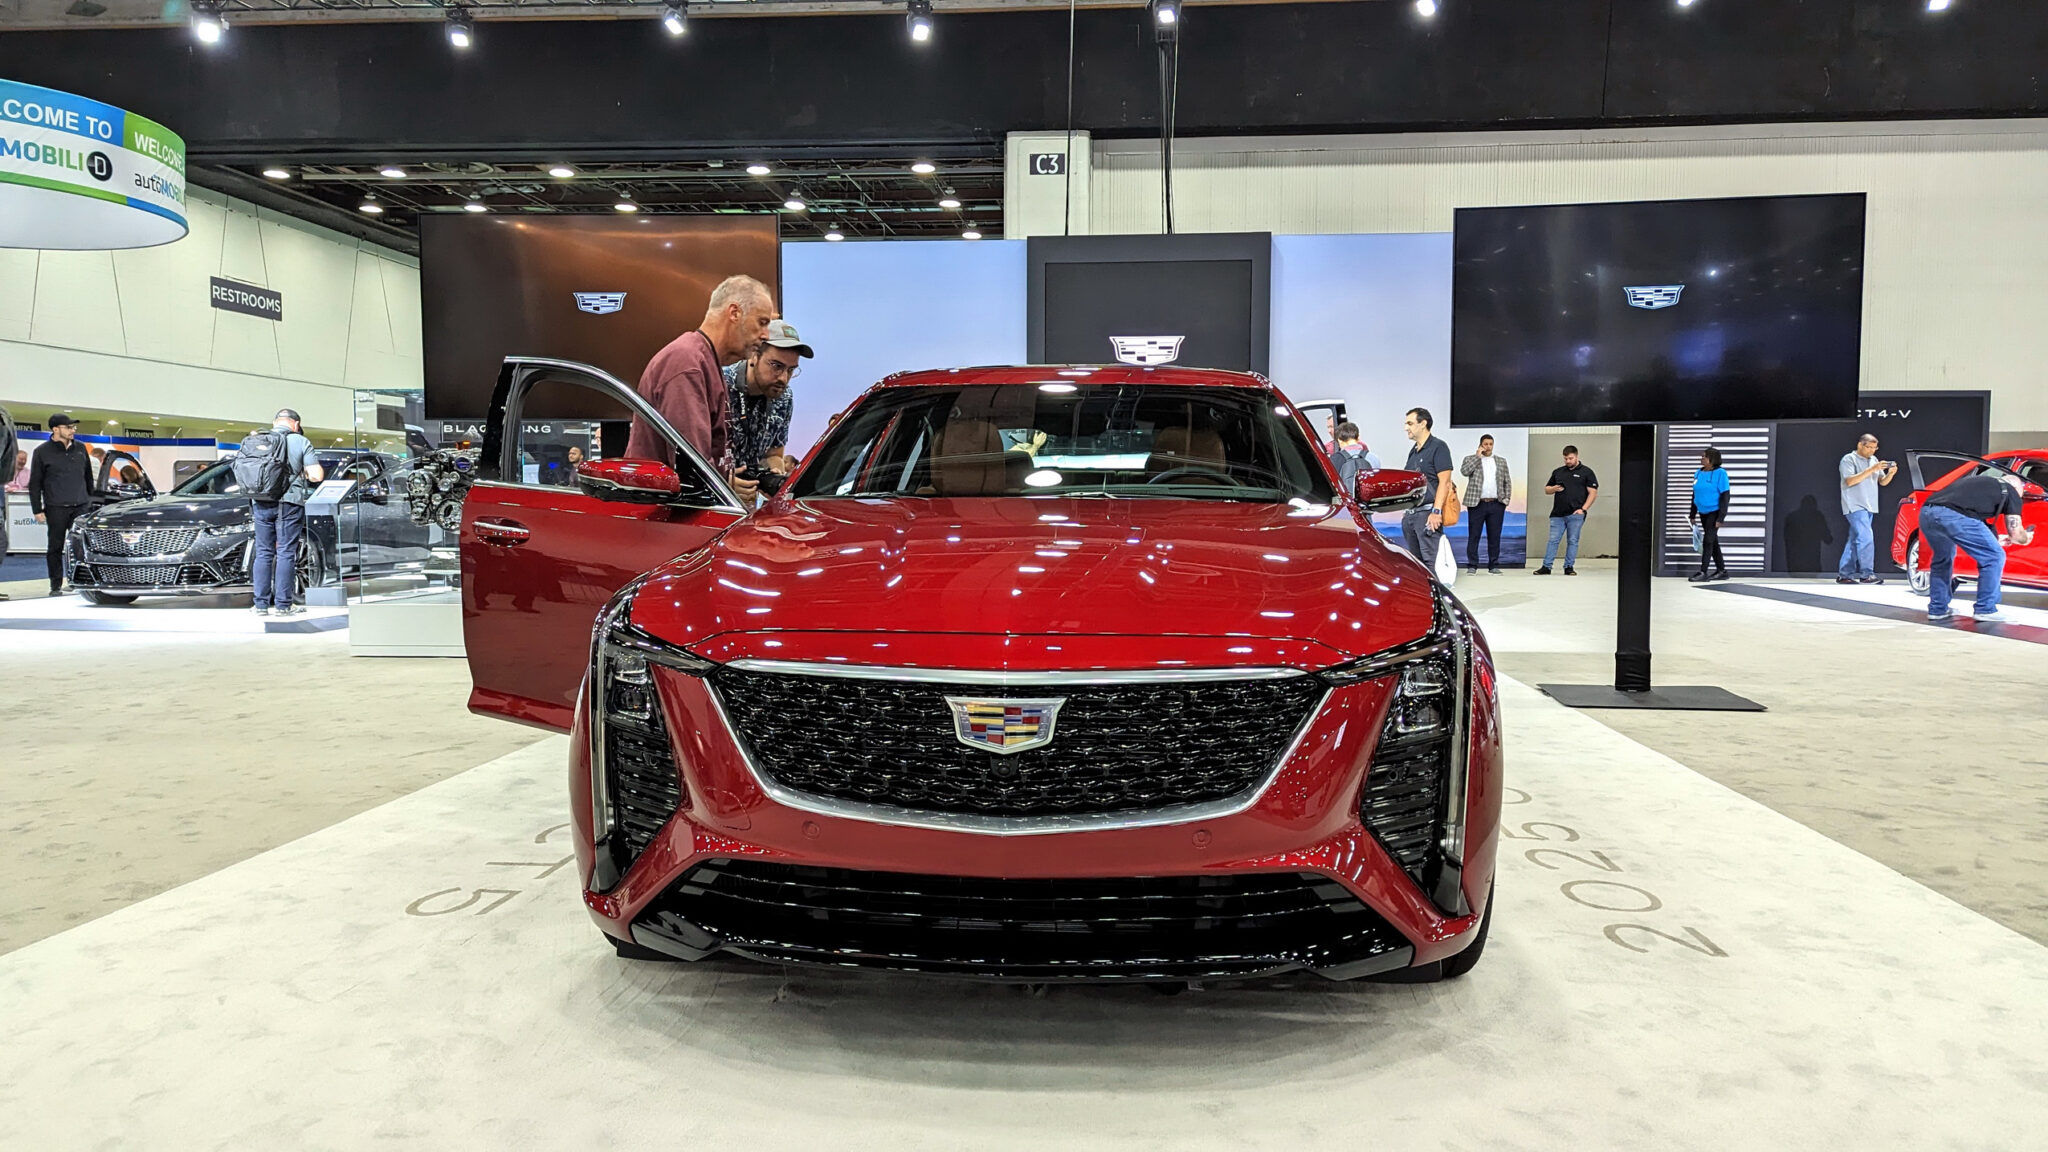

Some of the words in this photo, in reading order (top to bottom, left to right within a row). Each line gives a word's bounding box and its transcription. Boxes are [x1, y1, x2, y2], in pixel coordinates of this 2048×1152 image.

[0, 99, 80, 131] COME
[85, 115, 113, 139] TO
[1036, 154, 1059, 174] C3
[212, 285, 281, 313] RESTROOMS
[1500, 822, 1730, 957] 2025
